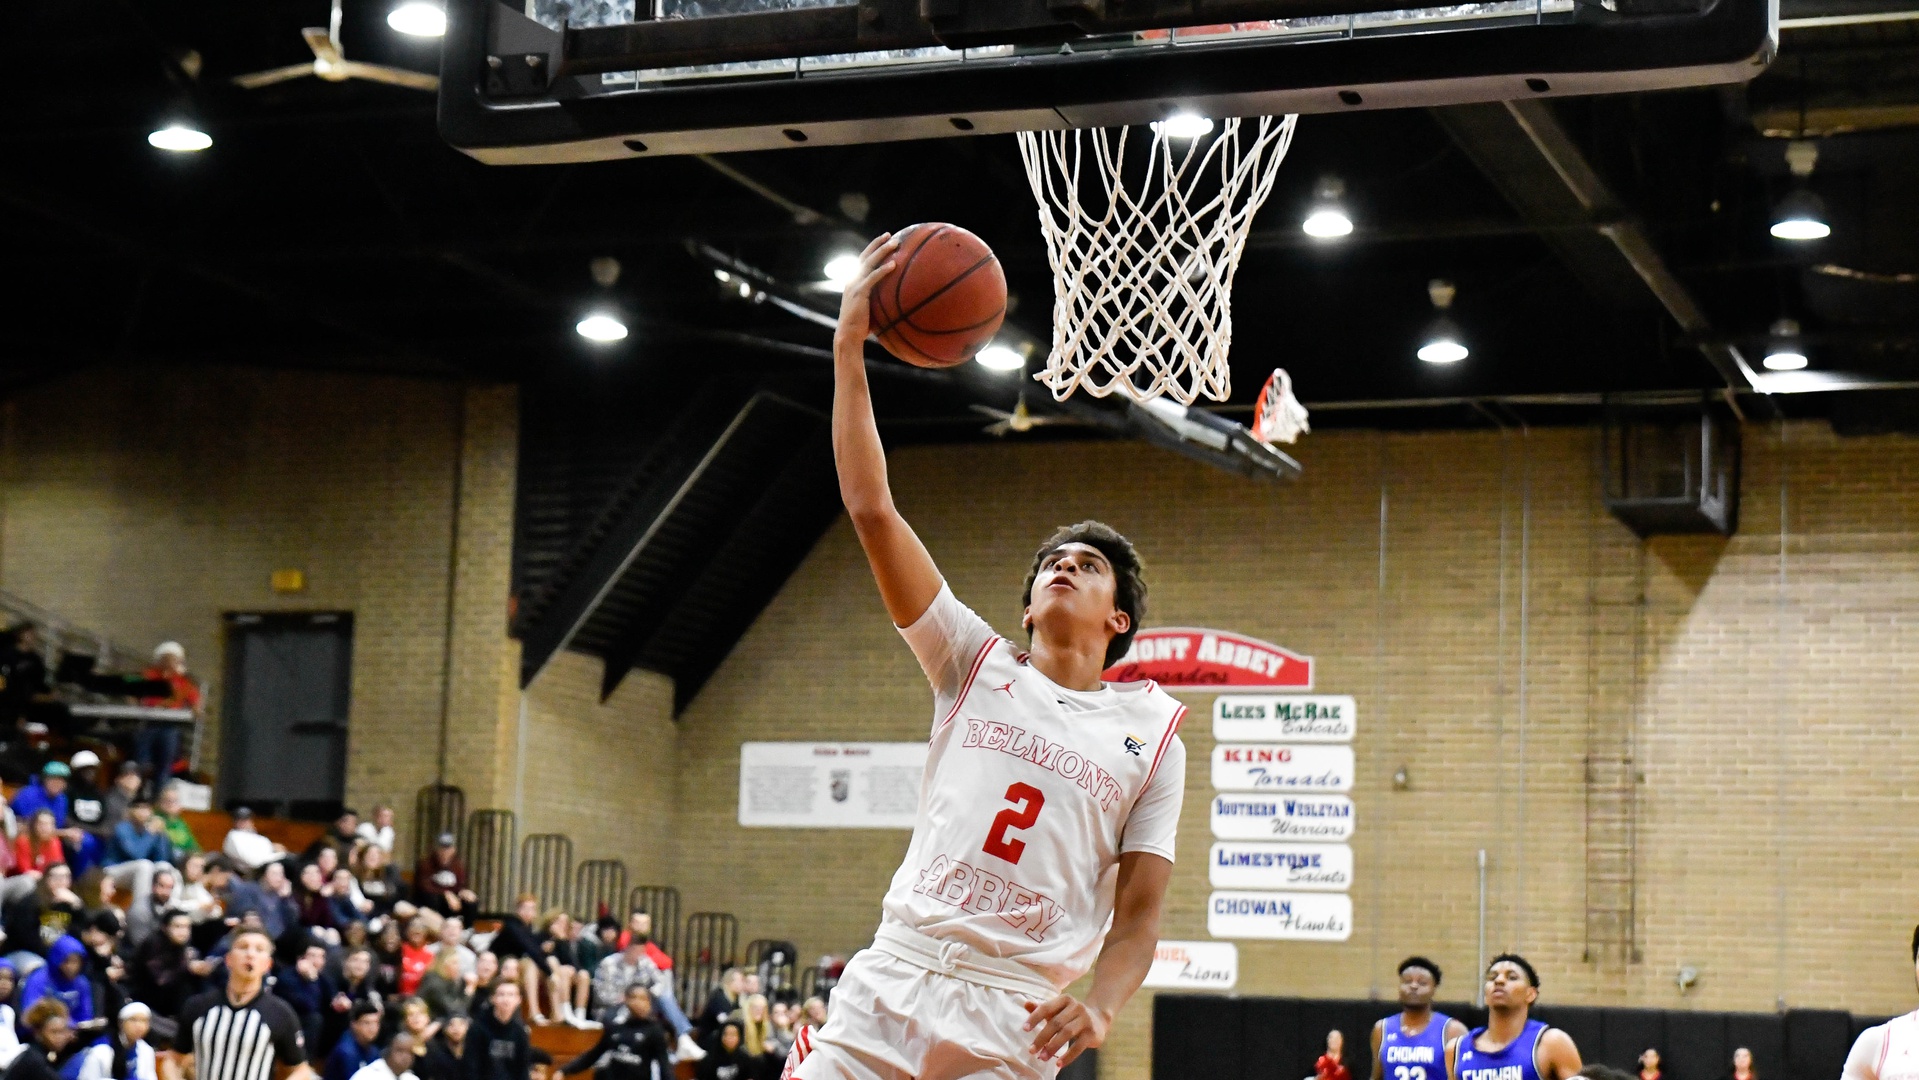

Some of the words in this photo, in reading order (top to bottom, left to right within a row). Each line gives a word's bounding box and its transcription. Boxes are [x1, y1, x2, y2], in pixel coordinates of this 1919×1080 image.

[1196, 633, 1284, 678] ABBEY
[1281, 715, 1349, 734] Bobcats
[962, 718, 1123, 812] BELMONT
[1224, 749, 1292, 762] KING
[1247, 767, 1342, 786] Tornado
[982, 782, 1046, 866] 2
[1270, 818, 1346, 835] Warriors
[1218, 849, 1322, 867] LIMESTONE
[1286, 862, 1347, 882] Saints
[913, 854, 1065, 943] ABBEY
[1214, 898, 1292, 915] CHOWAN
[1280, 911, 1344, 932] Hawks
[1179, 960, 1231, 980] Lions
[1386, 1045, 1435, 1064] CHOWAN
